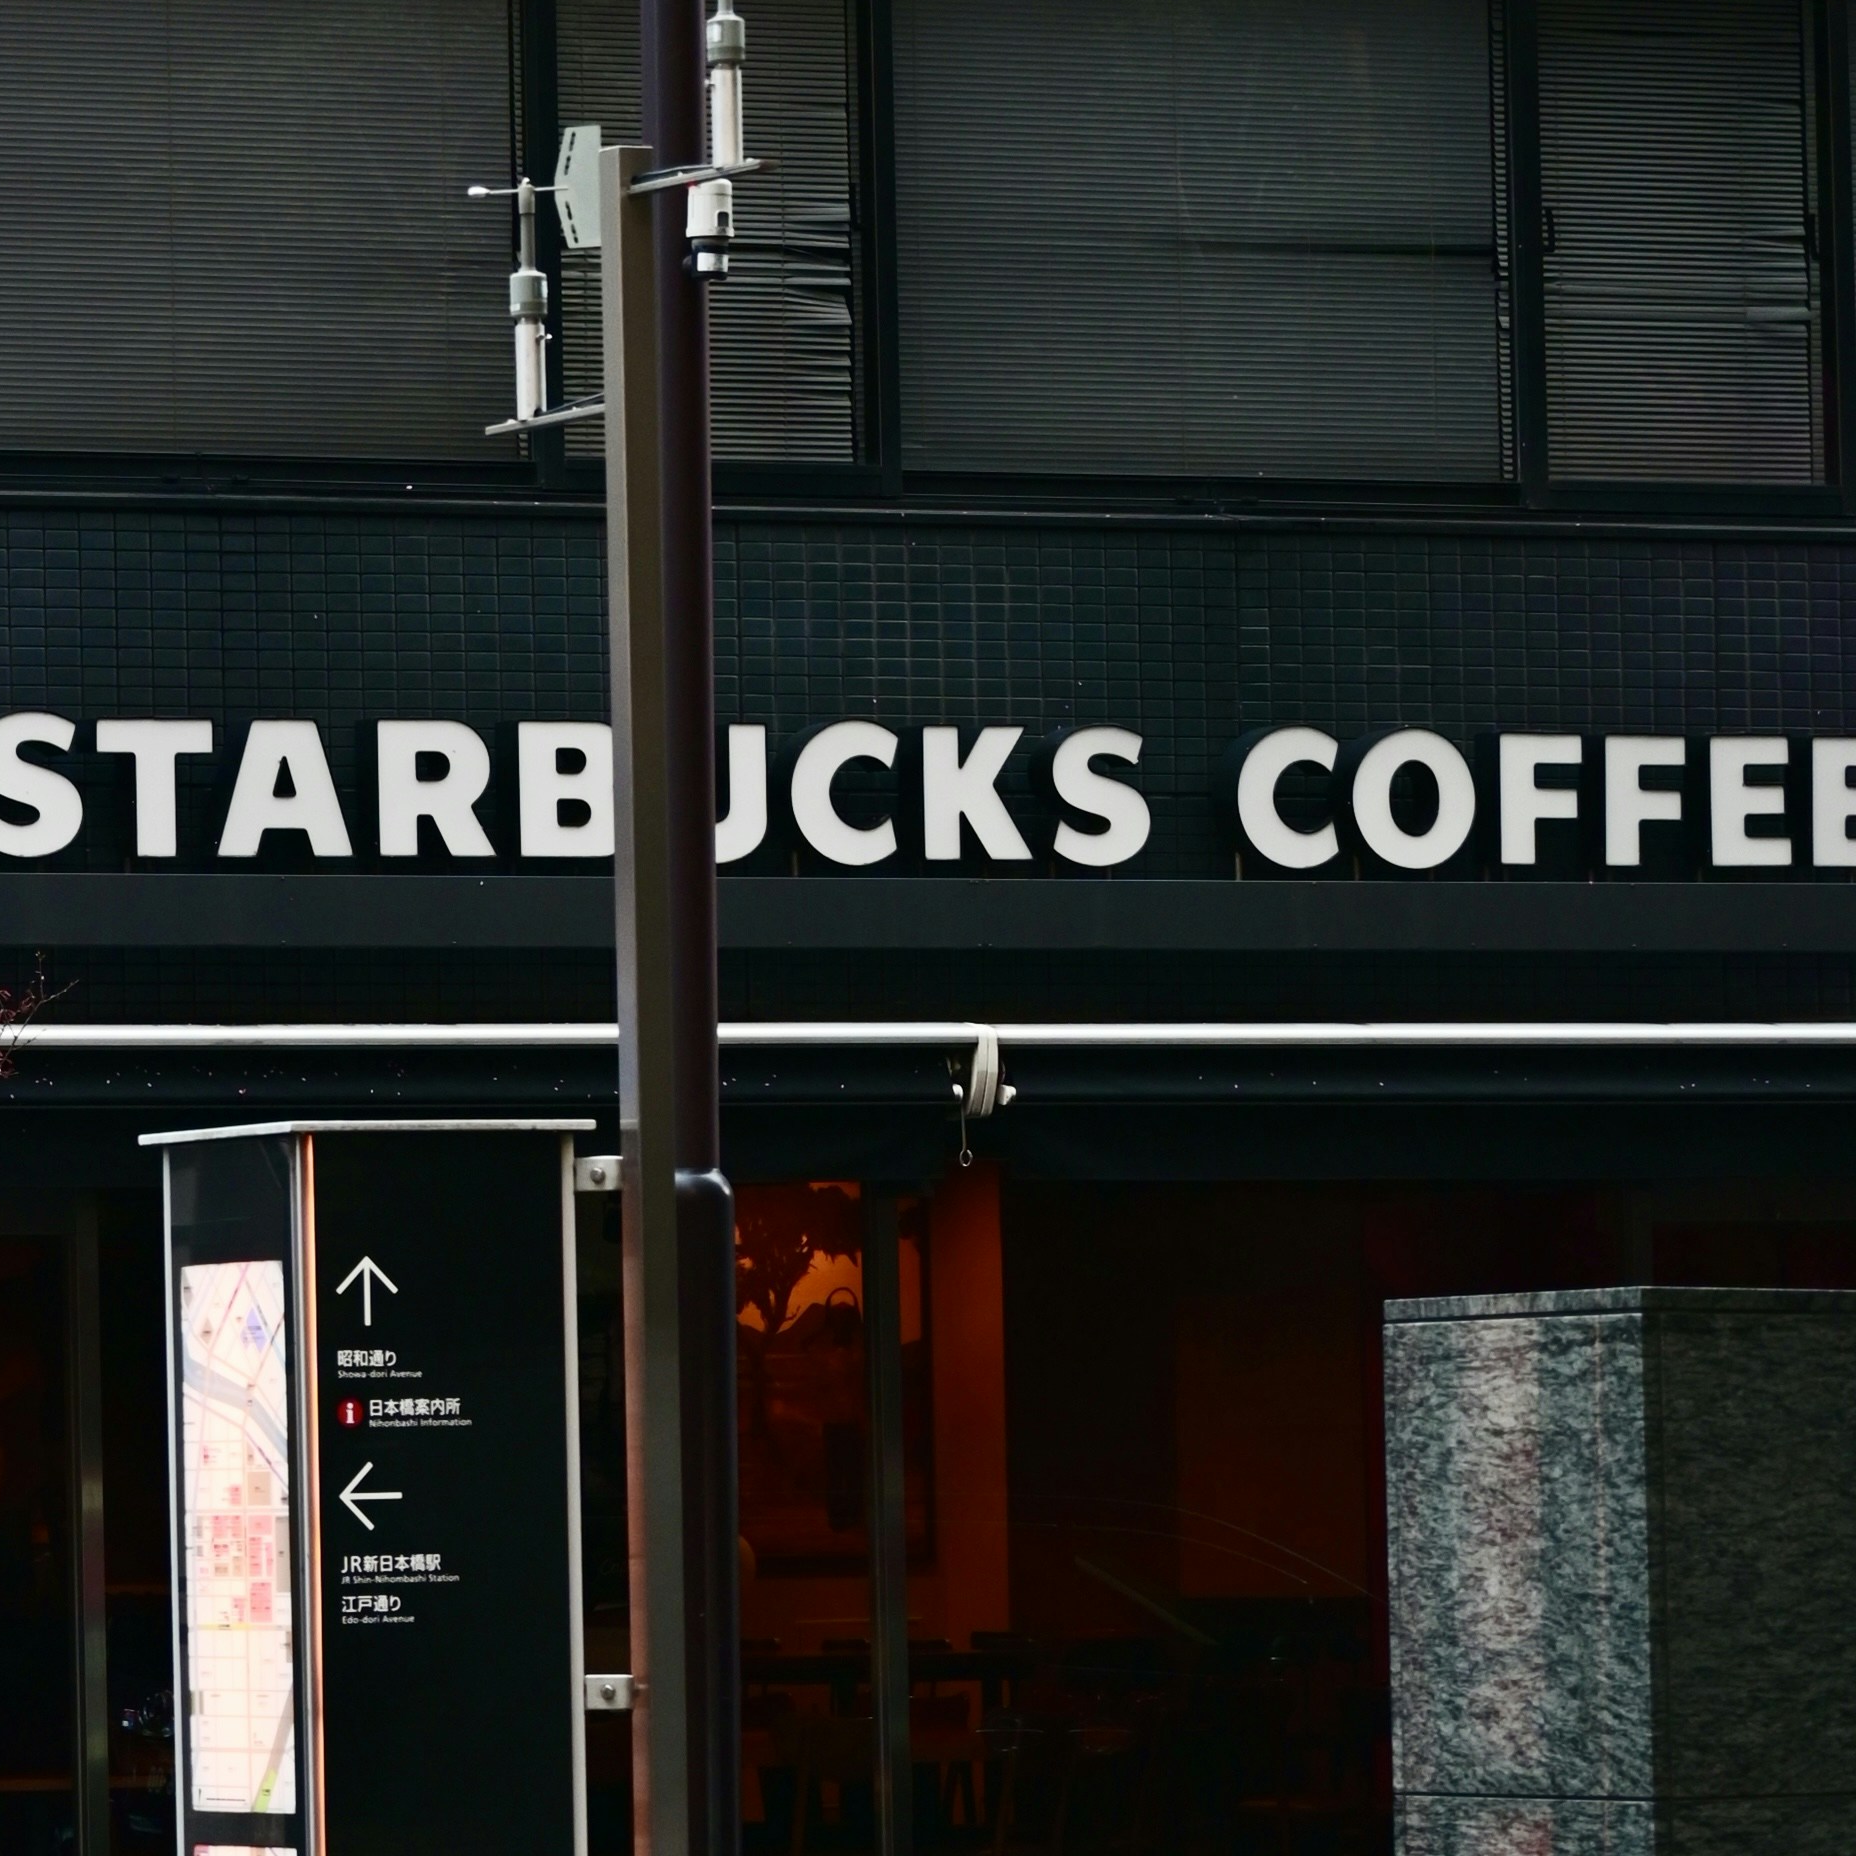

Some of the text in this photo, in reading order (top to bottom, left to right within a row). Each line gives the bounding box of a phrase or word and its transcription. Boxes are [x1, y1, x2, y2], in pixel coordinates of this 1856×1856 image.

[1236, 727, 1856, 869] COFFEE
[337, 1350, 397, 1367] 昭和通り
[337, 1369, 423, 1379] Showa-dori Avenue
[369, 1398, 461, 1416] 日本橋案内所
[420, 1417, 473, 1427] Information
[341, 1554, 441, 1574] JR新日本橋駅
[341, 1576, 351, 1585] JR
[428, 1573, 460, 1583] Station
[341, 1595, 402, 1613] 江戸通り
[342, 1615, 415, 1624] Edo-dori Avenue
